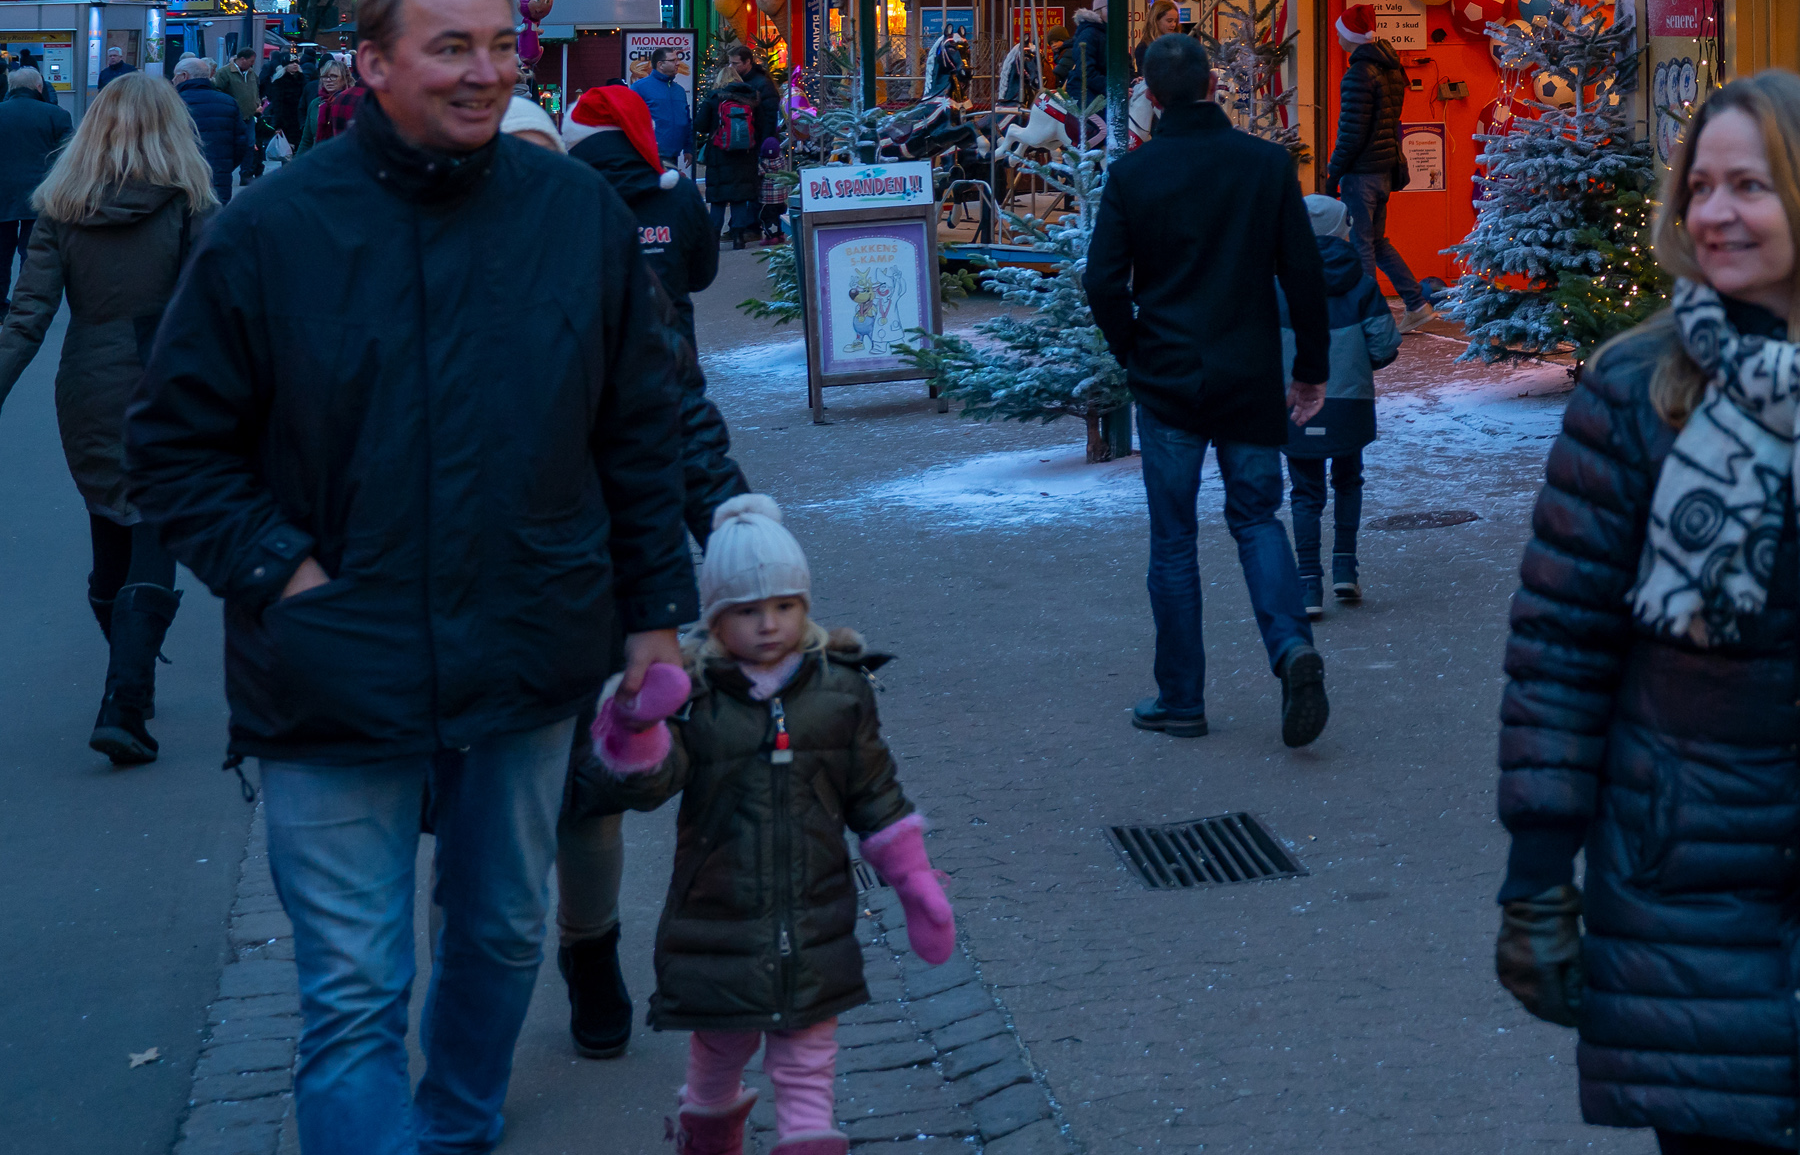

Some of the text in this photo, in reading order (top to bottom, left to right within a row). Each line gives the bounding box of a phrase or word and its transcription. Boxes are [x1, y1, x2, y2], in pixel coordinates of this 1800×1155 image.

[1385, 4, 1403, 12] Valg
[1666, 7, 1698, 29] senere!
[631, 36, 690, 46] MONACO's
[810, 176, 831, 199] PÅ
[834, 176, 905, 197] SPANDEN
[845, 244, 898, 256] BAKKENS
[850, 254, 895, 266] 5-KAMP
